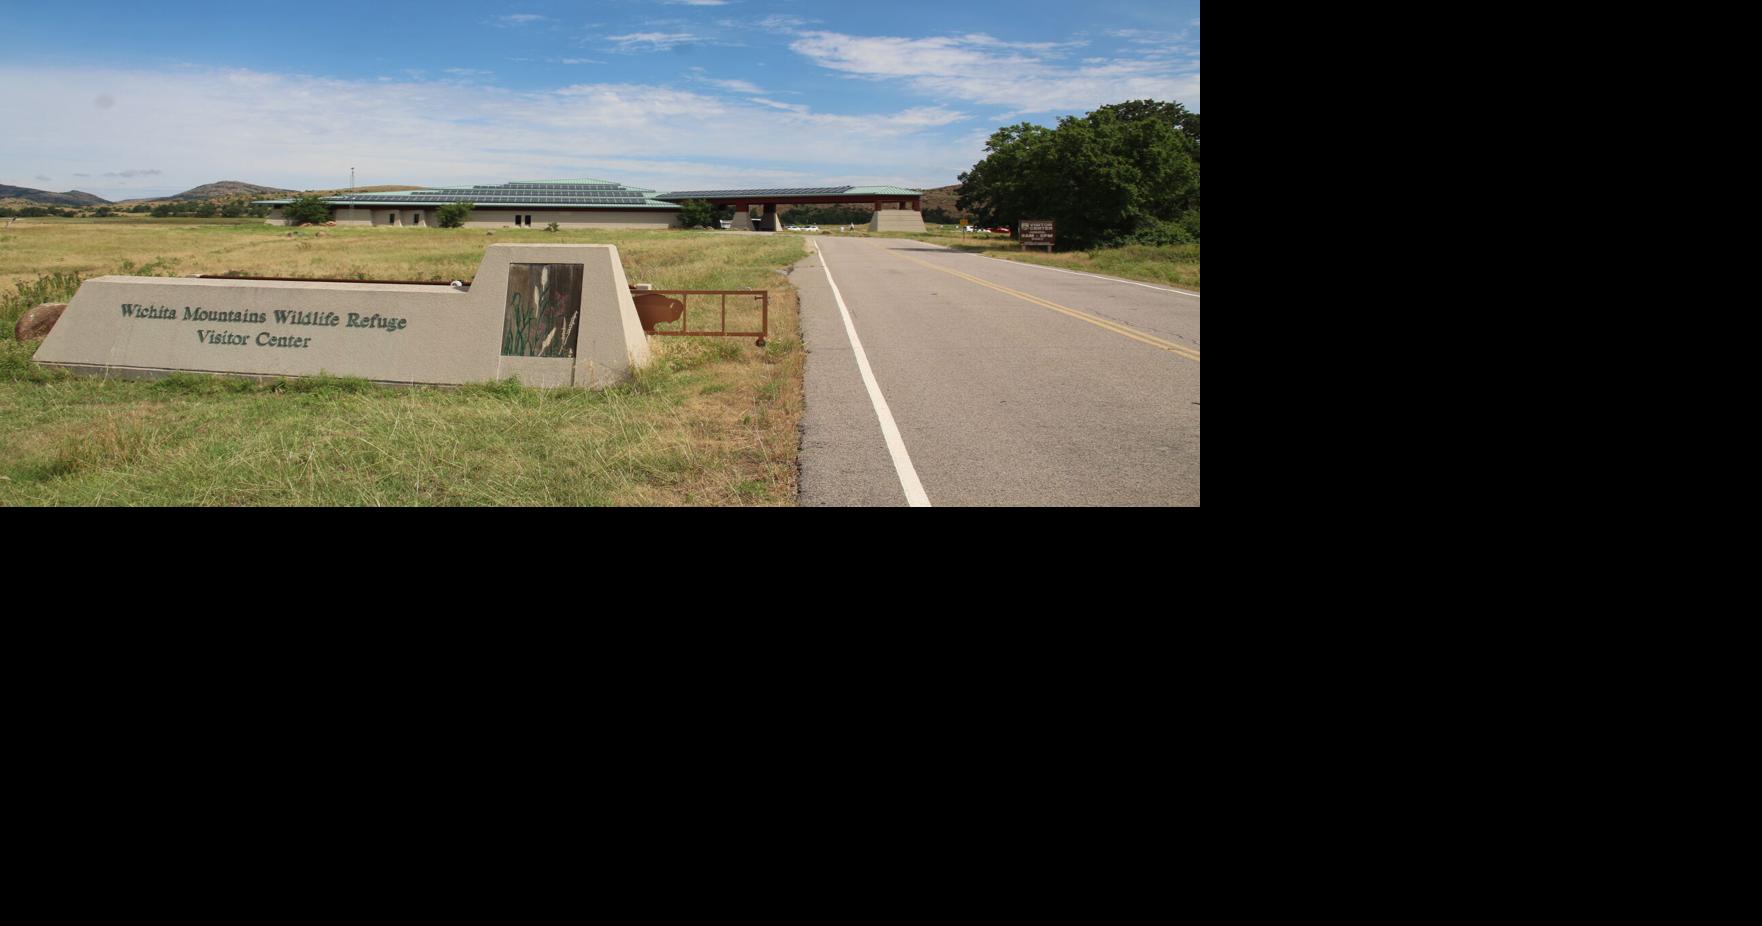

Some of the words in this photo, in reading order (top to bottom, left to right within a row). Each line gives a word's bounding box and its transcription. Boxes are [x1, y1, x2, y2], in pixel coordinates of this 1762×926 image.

[121, 304, 177, 320] Wichita
[182, 306, 267, 323] Mountains
[273, 309, 340, 327] Wildlife
[345, 312, 407, 332] Refuge
[196, 329, 250, 346] Visitor
[255, 332, 312, 348] Center
